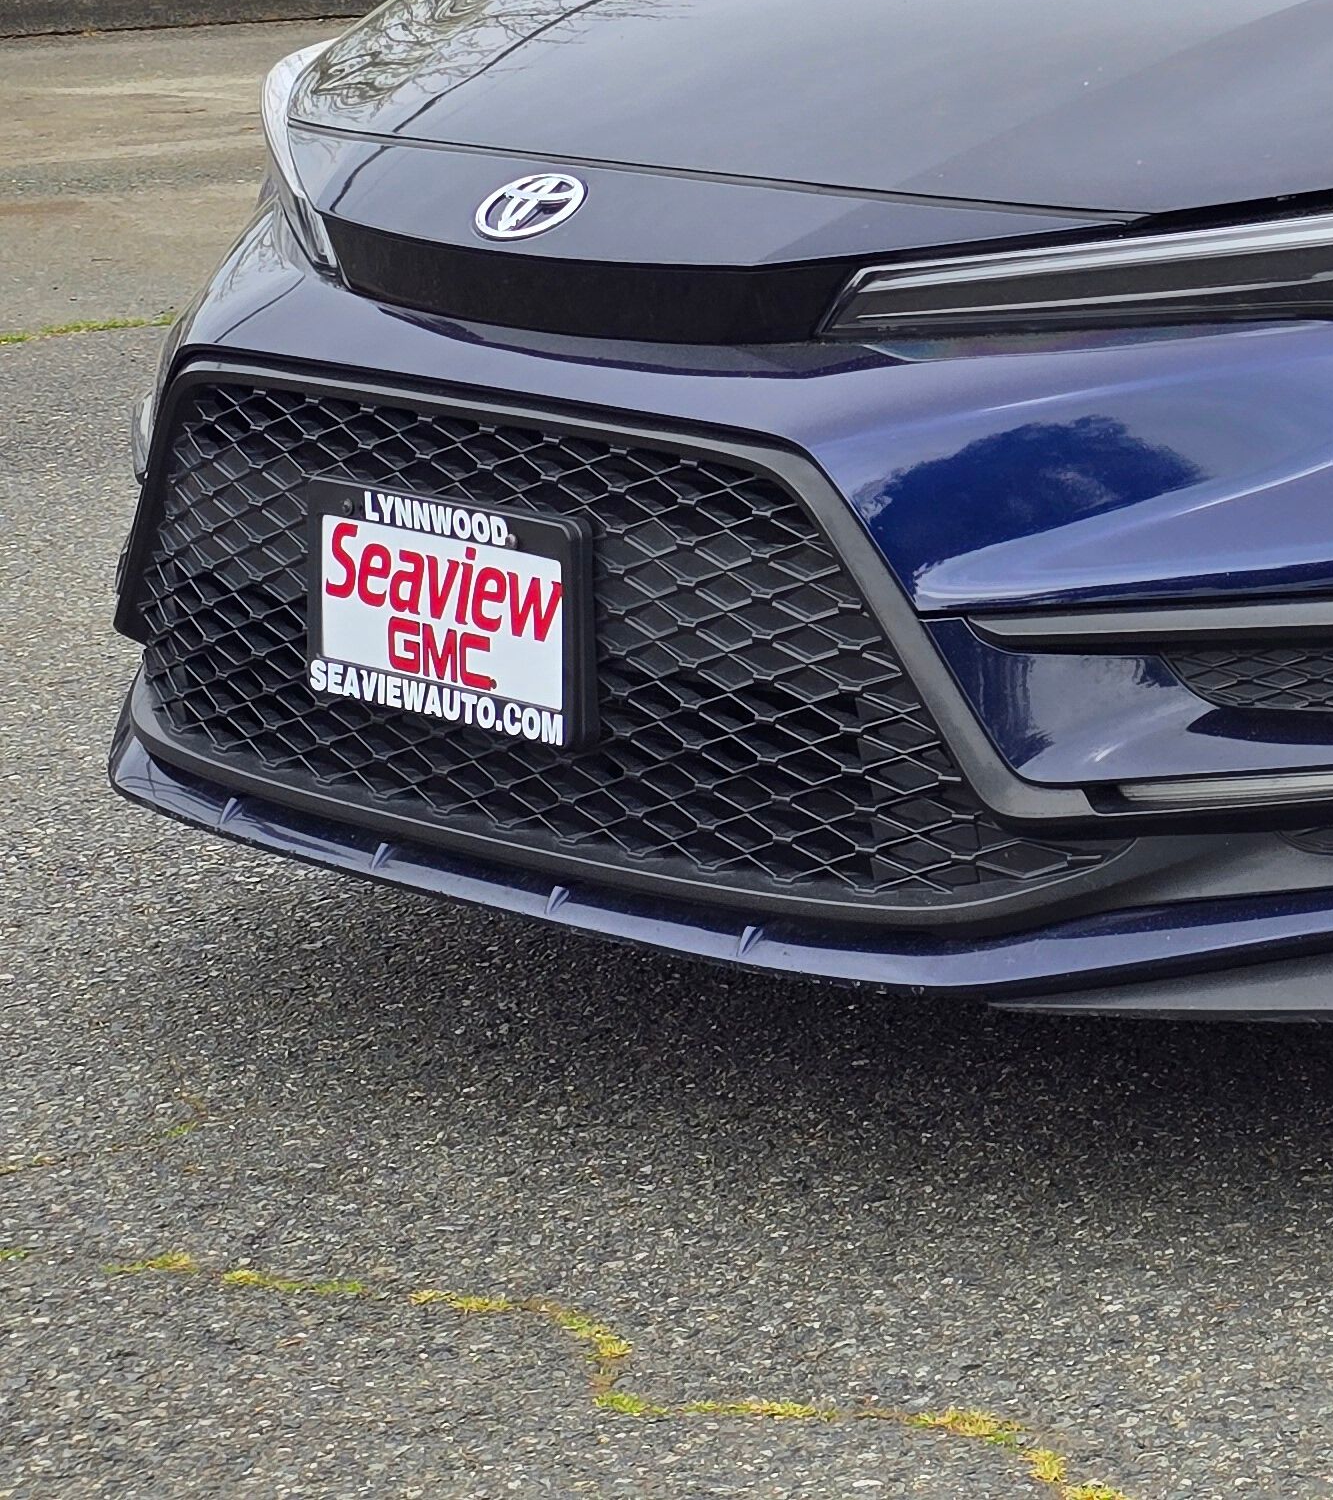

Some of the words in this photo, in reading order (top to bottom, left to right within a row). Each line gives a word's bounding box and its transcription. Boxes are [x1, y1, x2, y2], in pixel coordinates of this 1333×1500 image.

[364, 490, 509, 547] LYNNWOOD
[325, 522, 563, 643] Seaview
[387, 615, 498, 691] GMC
[310, 659, 563, 747] SEAVIEWAUTO.COM
